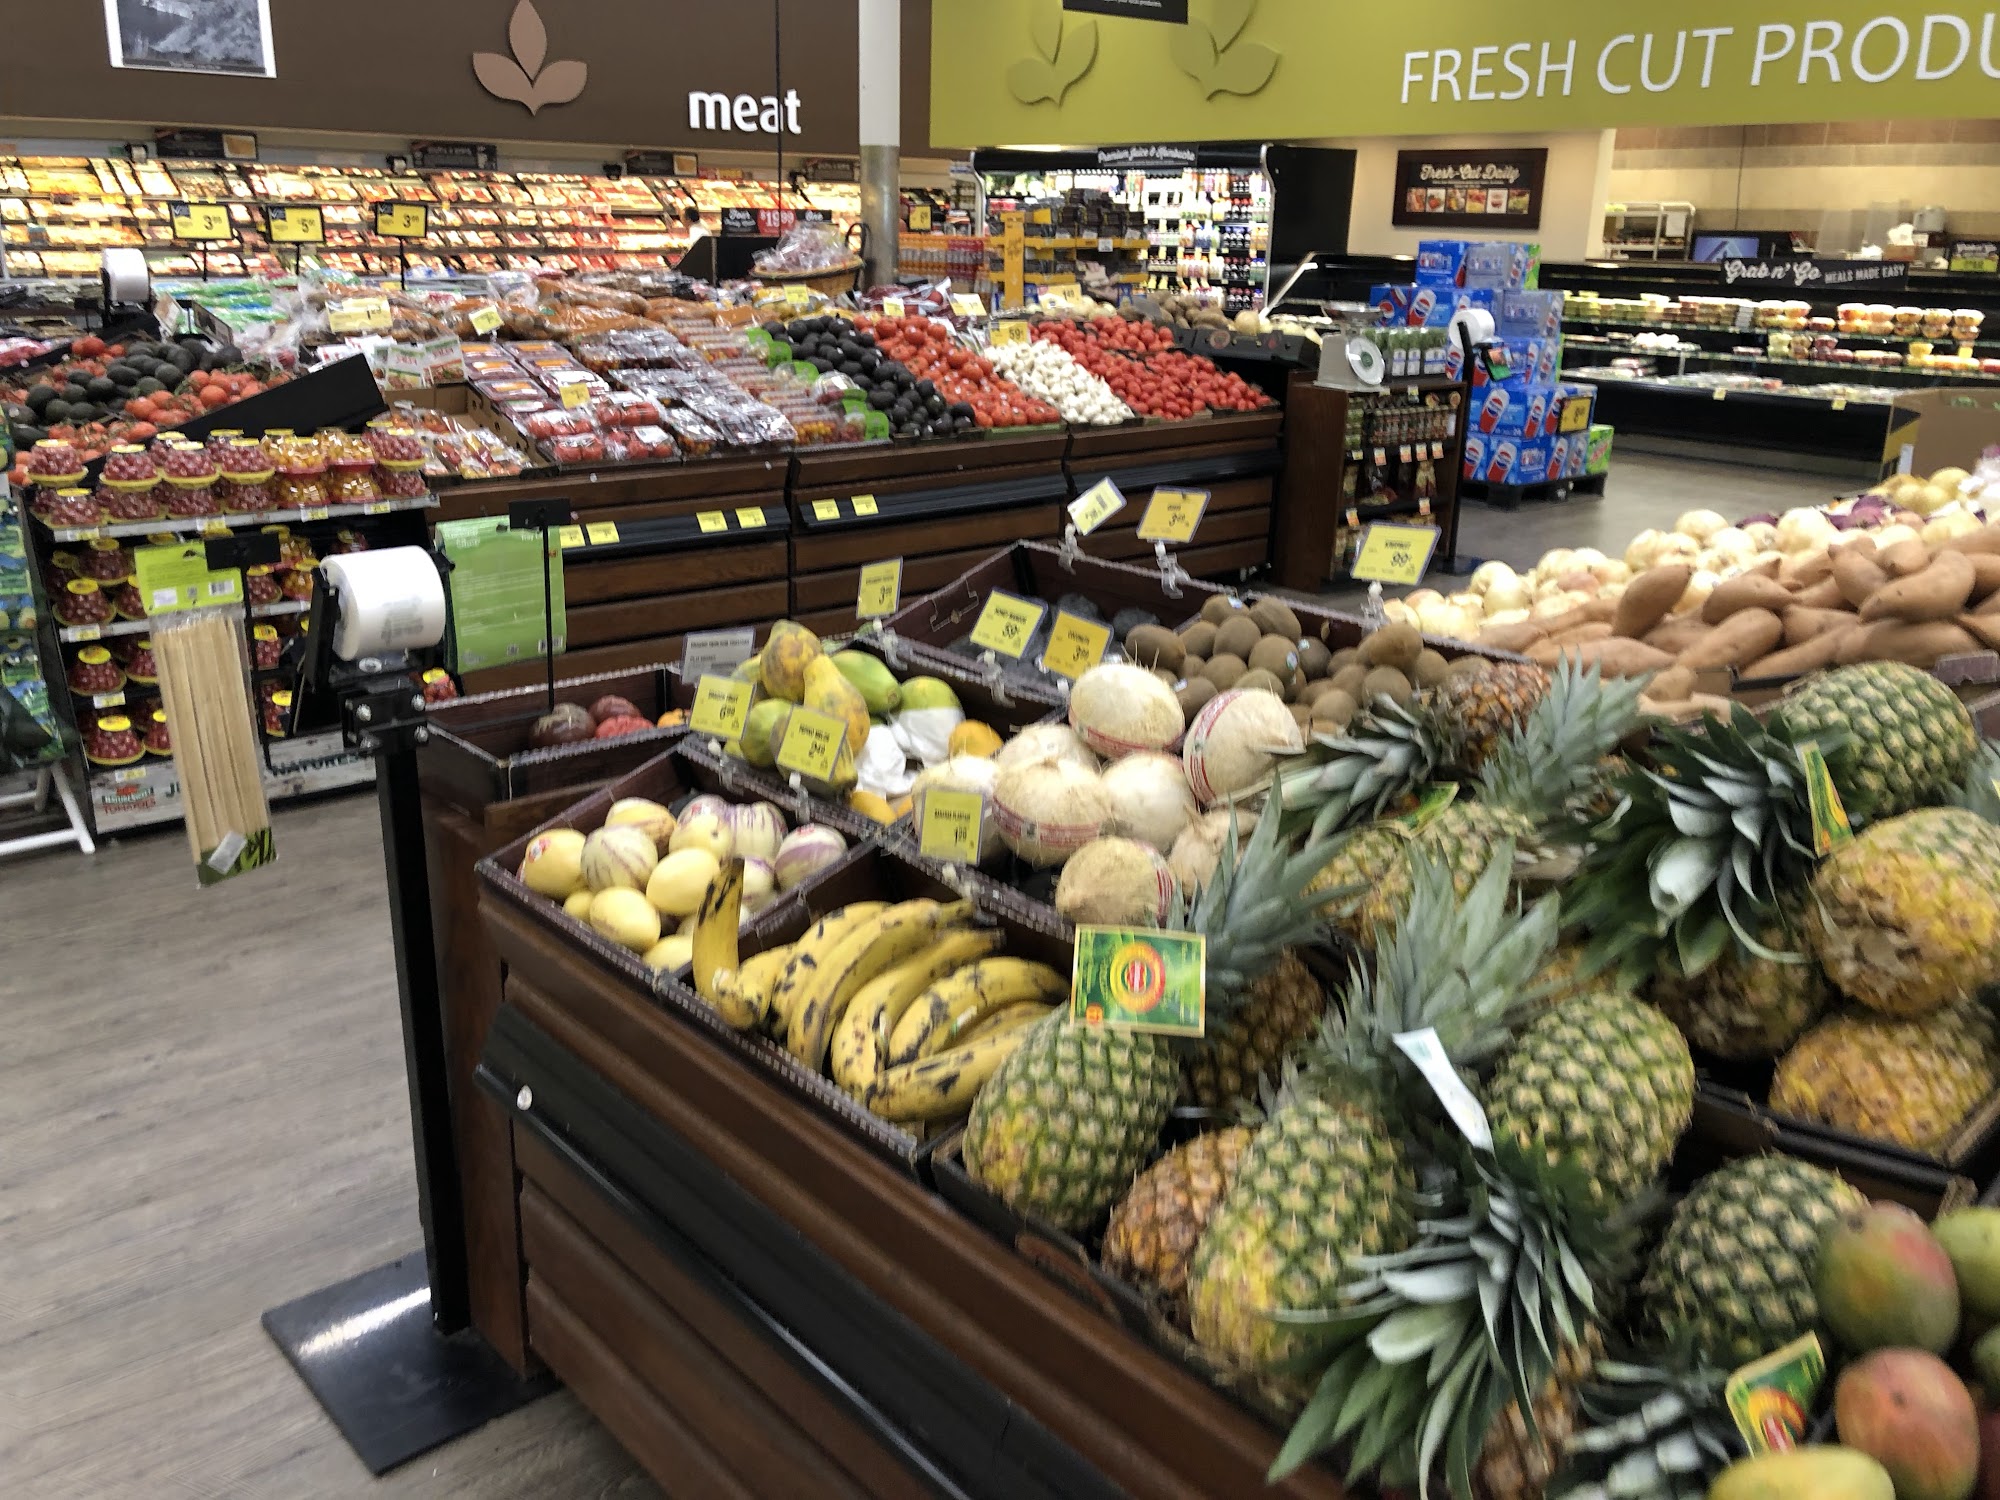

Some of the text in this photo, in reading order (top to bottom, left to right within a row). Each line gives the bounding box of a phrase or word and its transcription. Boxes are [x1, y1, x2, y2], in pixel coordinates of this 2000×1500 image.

[1401, 39, 1577, 103] FRESH
[1597, 27, 1733, 95] CUT
[688, 88, 801, 134] meat
[1482, 163, 1520, 183] Daily
[1724, 259, 1770, 284] Grab
[1793, 260, 1822, 286] Go
[1824, 271, 1853, 284] MEALS
[1855, 267, 1880, 281] MADE
[1882, 263, 1906, 278] EASY
